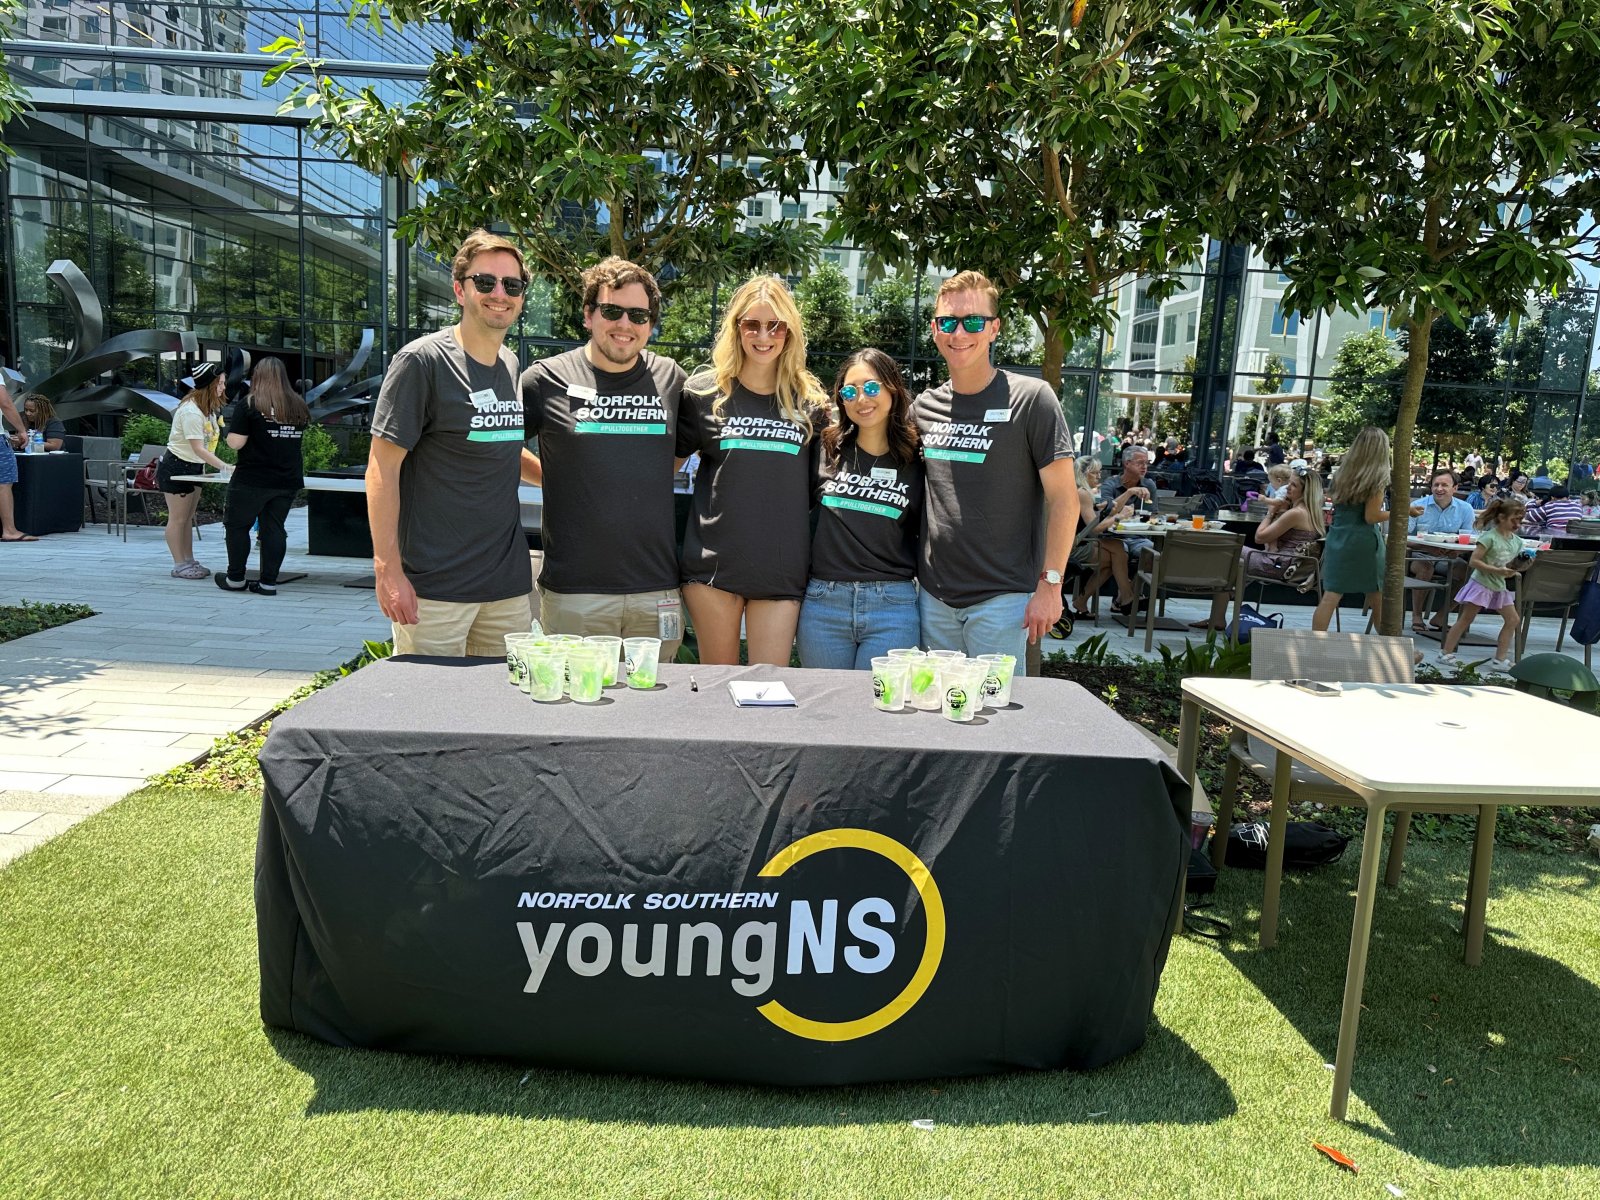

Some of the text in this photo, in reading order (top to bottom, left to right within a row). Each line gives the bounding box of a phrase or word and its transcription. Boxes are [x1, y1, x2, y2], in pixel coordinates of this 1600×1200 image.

[584, 395, 662, 407] NORFOLK
[575, 407, 668, 420] SOUTHERN
[727, 416, 801, 432] NORFOLK
[929, 421, 993, 437] NORFOLK
[720, 426, 805, 444] SOUTHERN
[922, 433, 993, 451] SOUTHERN
[834, 471, 910, 495] NORFOLK
[824, 480, 910, 508] SOUTHERN
[516, 891, 780, 910] NORFOLK SOUTHERN
